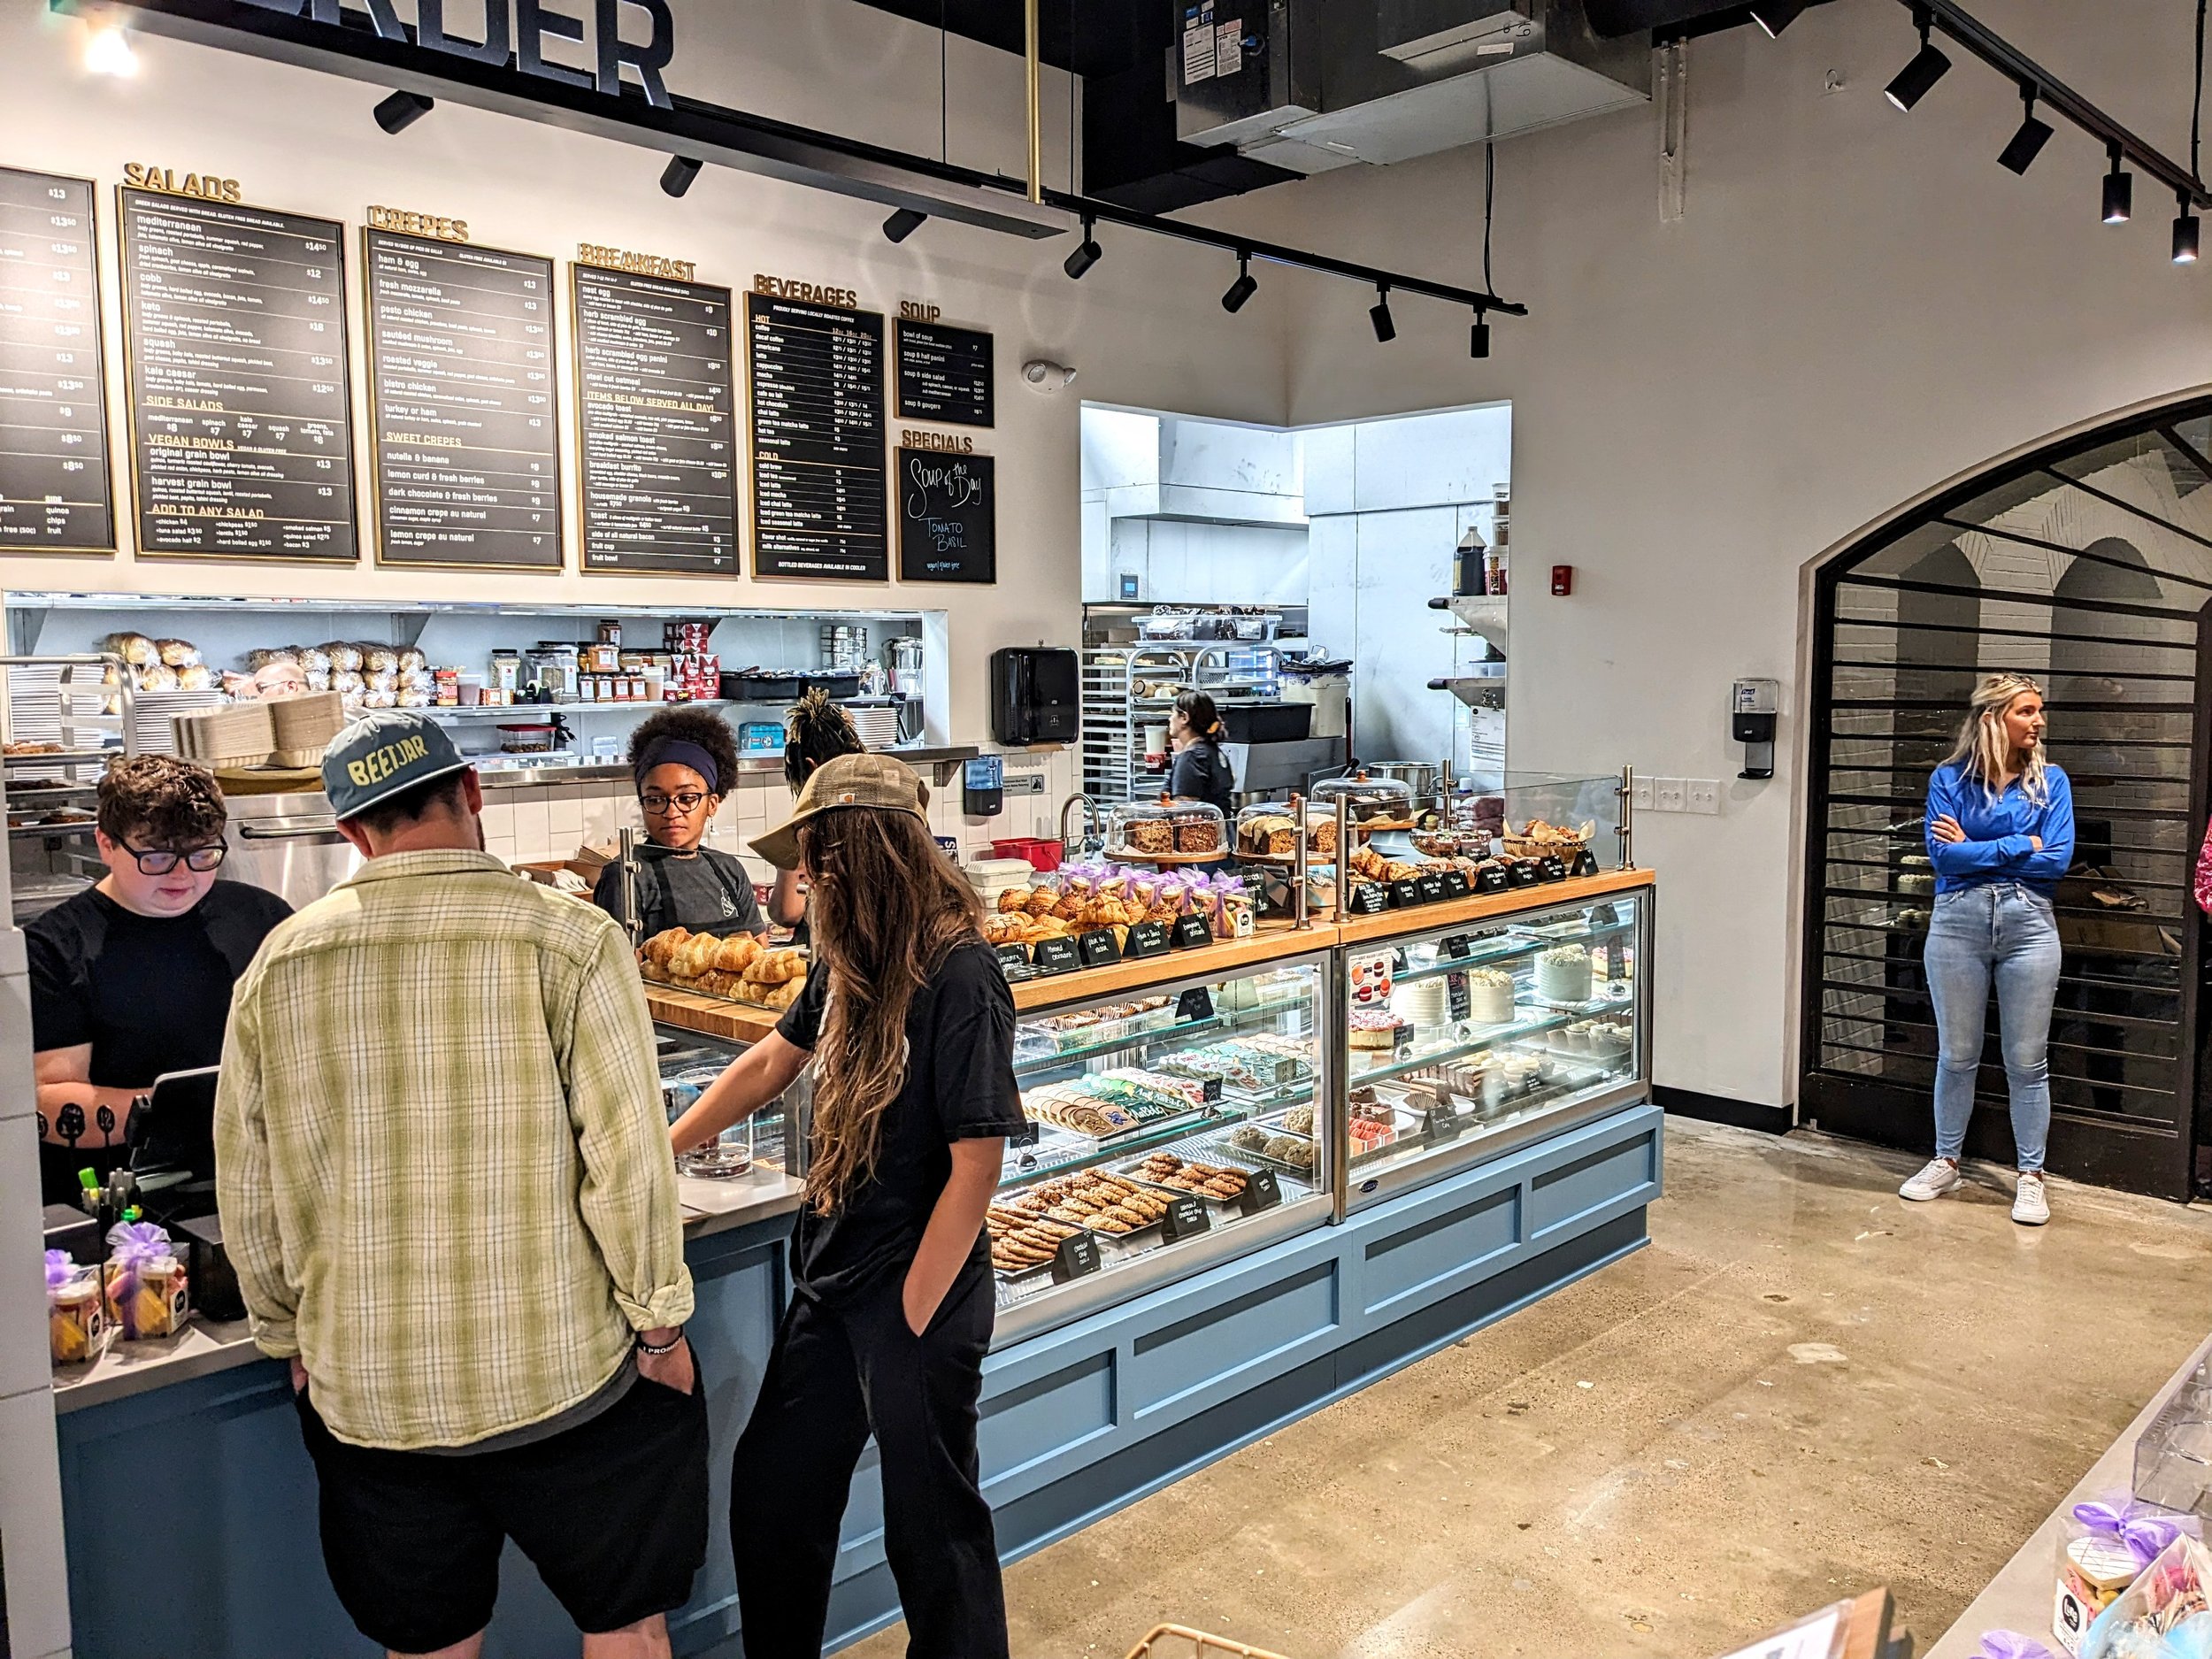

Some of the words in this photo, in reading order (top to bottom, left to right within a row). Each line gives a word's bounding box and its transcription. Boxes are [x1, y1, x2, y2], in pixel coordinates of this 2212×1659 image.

[250, 0, 674, 111] DER
[123, 162, 241, 203] SALADS
[137, 215, 201, 233] mediterranean
[368, 205, 468, 242] CREPES
[139, 243, 173, 257] spinach
[379, 254, 395, 265] ham
[405, 260, 419, 270] egg
[578, 243, 696, 282] BREAKFAST
[140, 273, 162, 284] cobb
[380, 280, 399, 291] fresh
[401, 283, 442, 296] mozzarella
[582, 286, 597, 295] nest
[754, 273, 856, 309] BEVERAGES
[142, 302, 160, 311] keto
[381, 305, 402, 316] pesto
[403, 309, 433, 319] chicken
[791, 307, 807, 316] SERVING
[901, 301, 941, 323] SOUP
[584, 310, 598, 319] herb
[600, 312, 634, 324] scrambled
[634, 317, 647, 326] egg
[756, 314, 770, 323] HOT
[414, 333, 453, 346] mushroom
[903, 330, 915, 339] bowl
[143, 338, 176, 349] squash
[756, 343, 780, 352] americano
[383, 355, 411, 365] roasted
[413, 359, 437, 369] veggie
[585, 346, 600, 355] herb
[602, 349, 634, 359] scrambled
[636, 353, 648, 362] egg
[649, 355, 668, 364] panini
[145, 365, 163, 376] kale
[166, 368, 196, 379] caesar
[757, 362, 783, 371] cappuccino
[384, 379, 406, 389] bistro
[408, 381, 436, 393] chicken
[616, 377, 641, 386] oatmeal
[147, 396, 173, 406] SIDE
[177, 398, 223, 411] SALADS
[587, 391, 613, 401] ITEMS
[615, 394, 644, 404] BELOW
[646, 398, 678, 408] SERVED
[696, 403, 714, 412] DAY!
[588, 402, 613, 411] avocado
[766, 400, 788, 409] chocolate
[385, 403, 409, 416] turkey
[421, 408, 437, 417] ham
[149, 434, 188, 448] VEGAN
[194, 437, 234, 449] BOWLS
[387, 432, 420, 443] SWEET
[424, 434, 462, 447] CREPES
[615, 434, 638, 443] salmon
[902, 429, 972, 454] SPECIALS
[150, 448, 182, 458] original
[187, 450, 207, 460] grain
[210, 451, 230, 461] bowl
[387, 452, 412, 461] nutella
[423, 454, 449, 465] banana
[759, 451, 779, 460] COLD
[589, 460, 619, 470] breakfast
[151, 476, 184, 487] harvest
[188, 479, 209, 488] grain
[211, 480, 232, 489] bowl
[388, 469, 411, 479] lemon
[413, 472, 429, 480] curd
[439, 473, 457, 482] fresh
[460, 475, 485, 485] berries
[945, 470, 954, 496] of
[953, 463, 968, 476] the
[388, 488, 406, 496] dark
[408, 489, 442, 499] chocolate
[452, 492, 471, 502] fresh
[472, 494, 497, 503] berries
[951, 476, 982, 508] Day
[152, 503, 177, 514] ADD
[180, 505, 195, 515] TO
[199, 506, 222, 516] ANY
[227, 508, 264, 518] SALAD
[389, 505, 426, 516] cinnamon
[427, 509, 449, 518] crepe
[461, 511, 486, 519] naturel
[390, 529, 413, 539] lemon
[415, 532, 436, 541] crepe
[449, 534, 474, 542] naturel
[347, 734, 429, 787] BEETJAR
